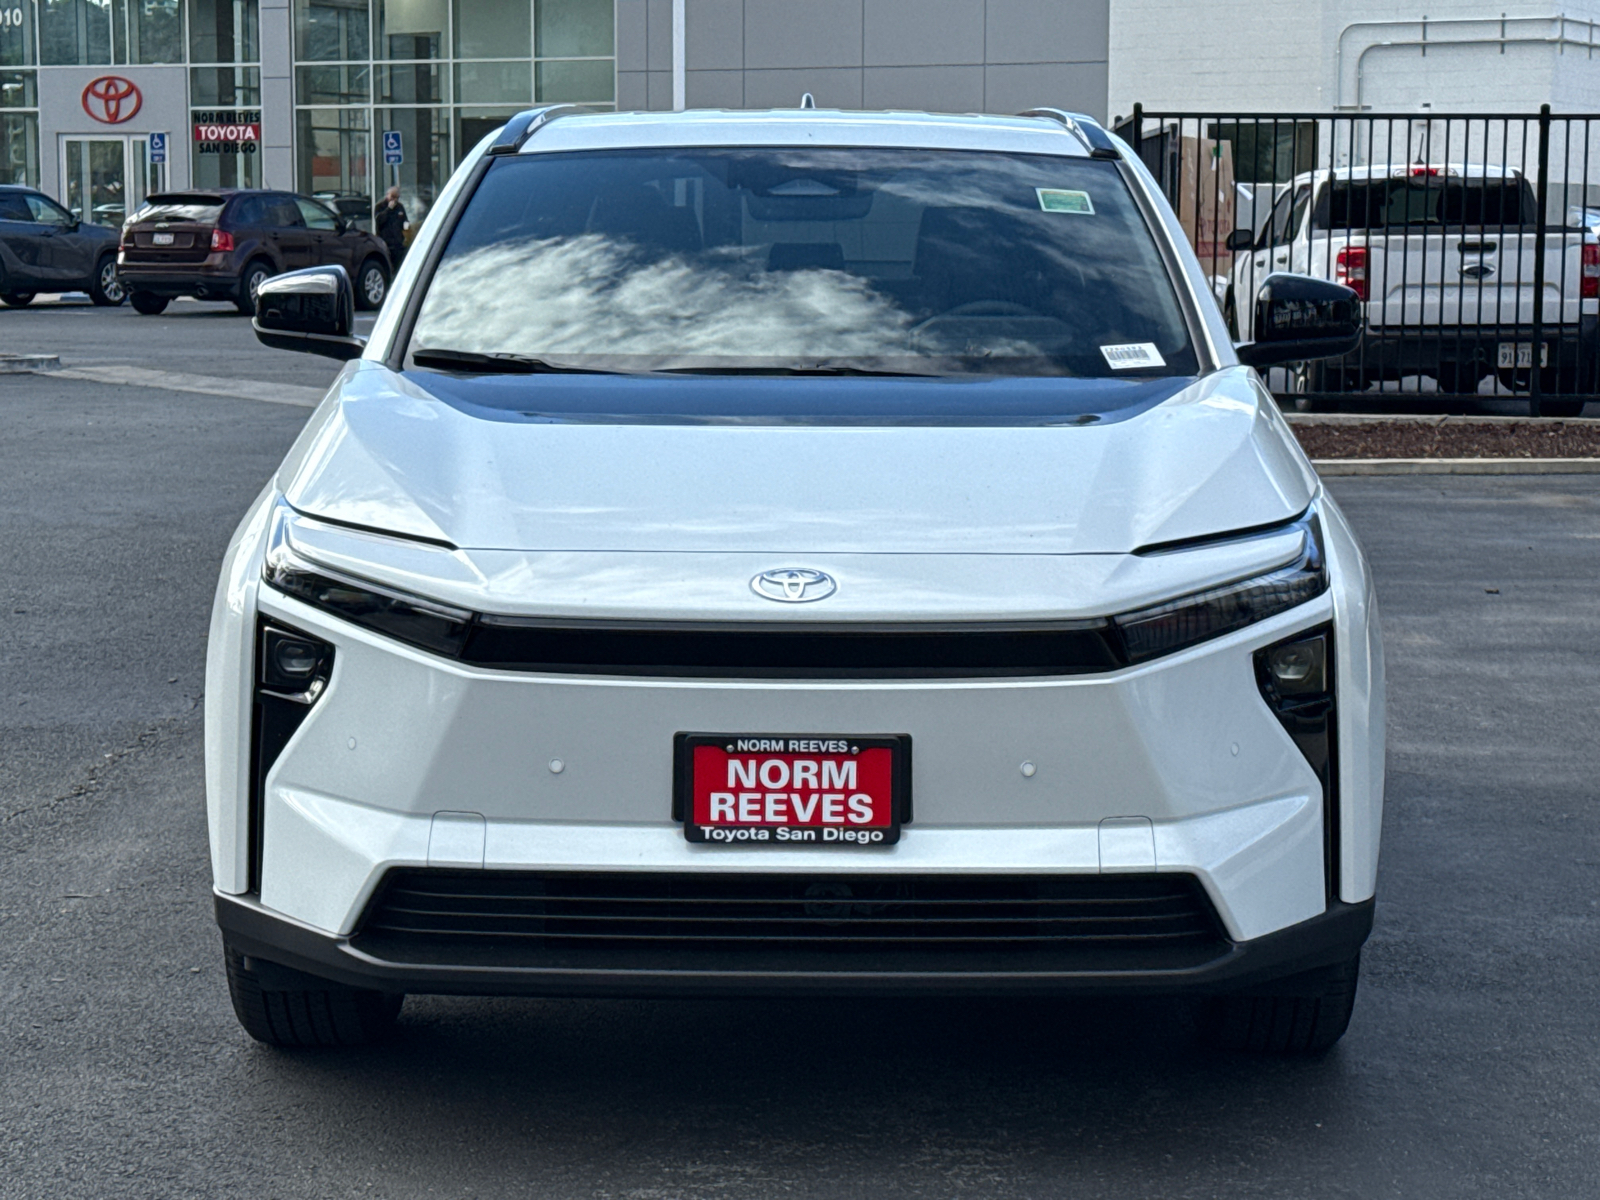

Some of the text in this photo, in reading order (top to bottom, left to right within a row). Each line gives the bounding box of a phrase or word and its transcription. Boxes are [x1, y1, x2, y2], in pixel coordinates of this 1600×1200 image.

[0, 8, 22, 26] 10
[194, 112, 259, 123] NORM REEVES
[199, 126, 255, 140] TOYOTA
[199, 142, 256, 154] SAN DIEGO
[737, 739, 848, 753] NORM REEVES
[709, 759, 874, 823] NORM REEVES
[701, 826, 884, 844] Toyota San Diego
